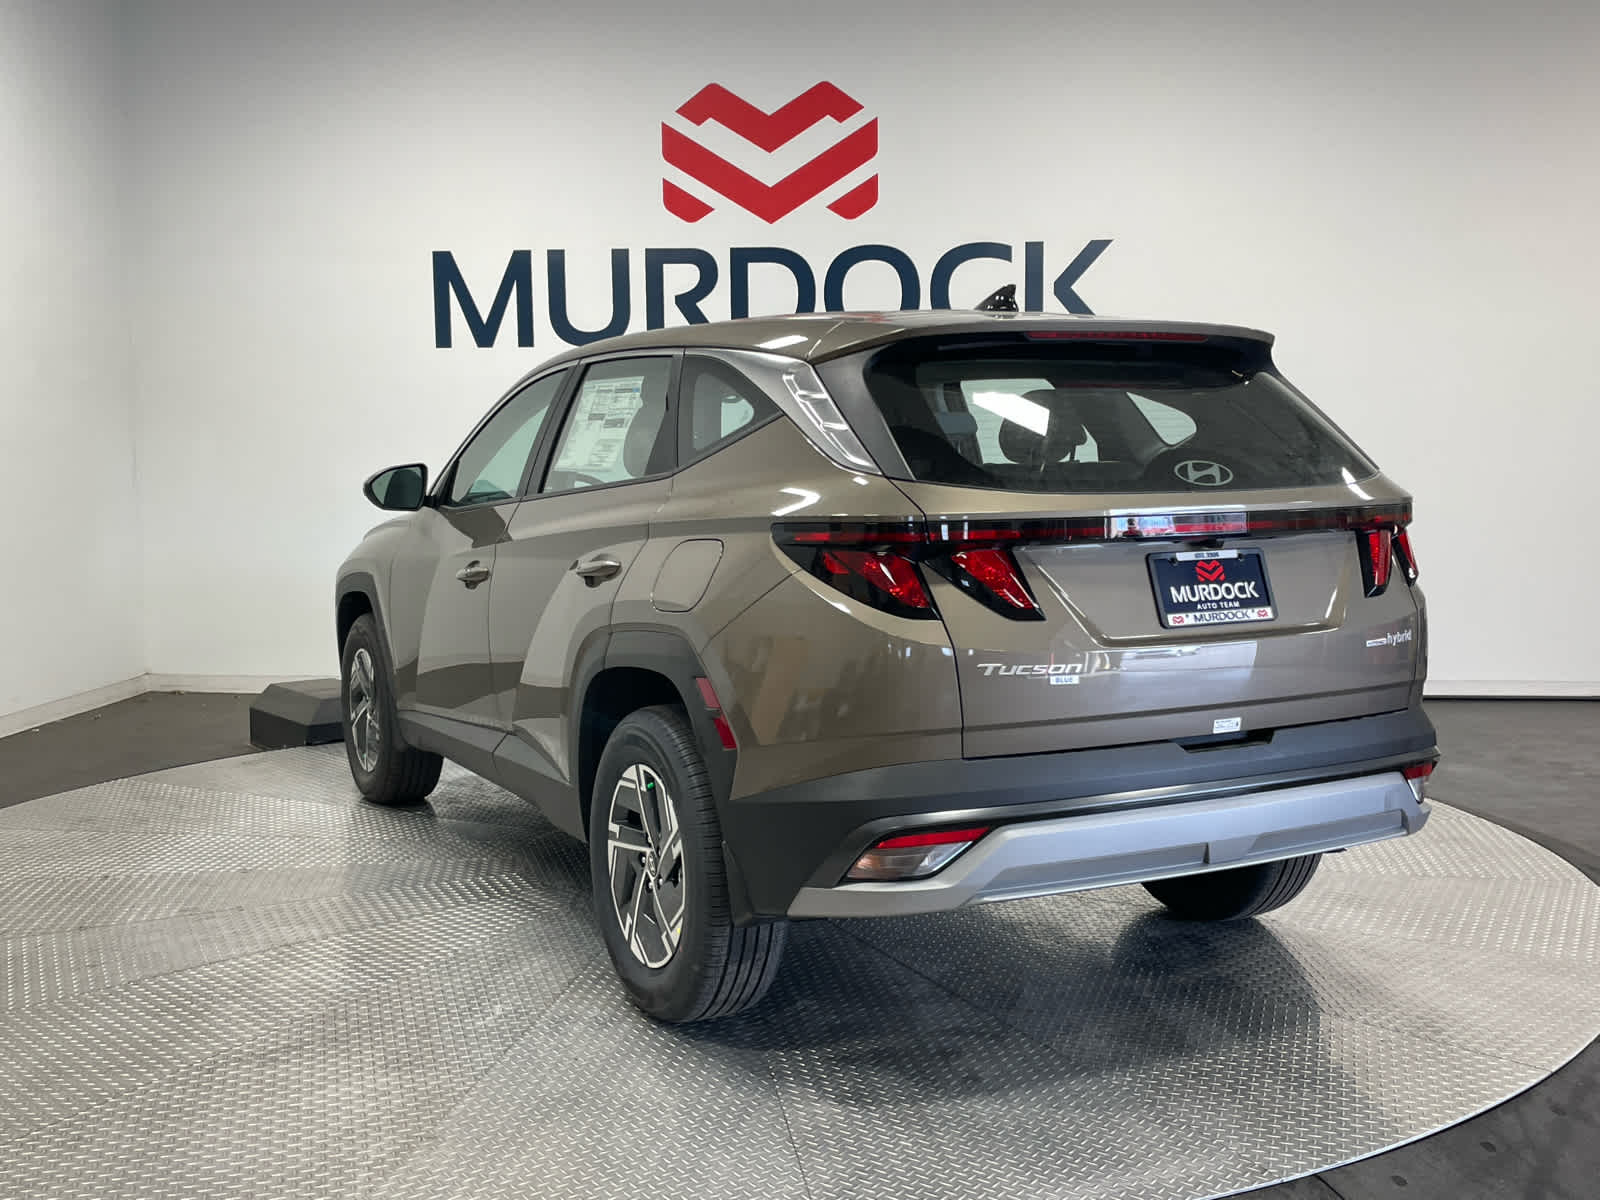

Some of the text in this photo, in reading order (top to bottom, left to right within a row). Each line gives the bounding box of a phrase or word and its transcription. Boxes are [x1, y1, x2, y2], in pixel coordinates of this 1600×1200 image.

[432, 239, 1113, 348] MURDOCK
[1169, 580, 1260, 603] MURDOCK
[1197, 601, 1240, 610] AUTO TEAM
[1193, 609, 1250, 623] MURDOCK
